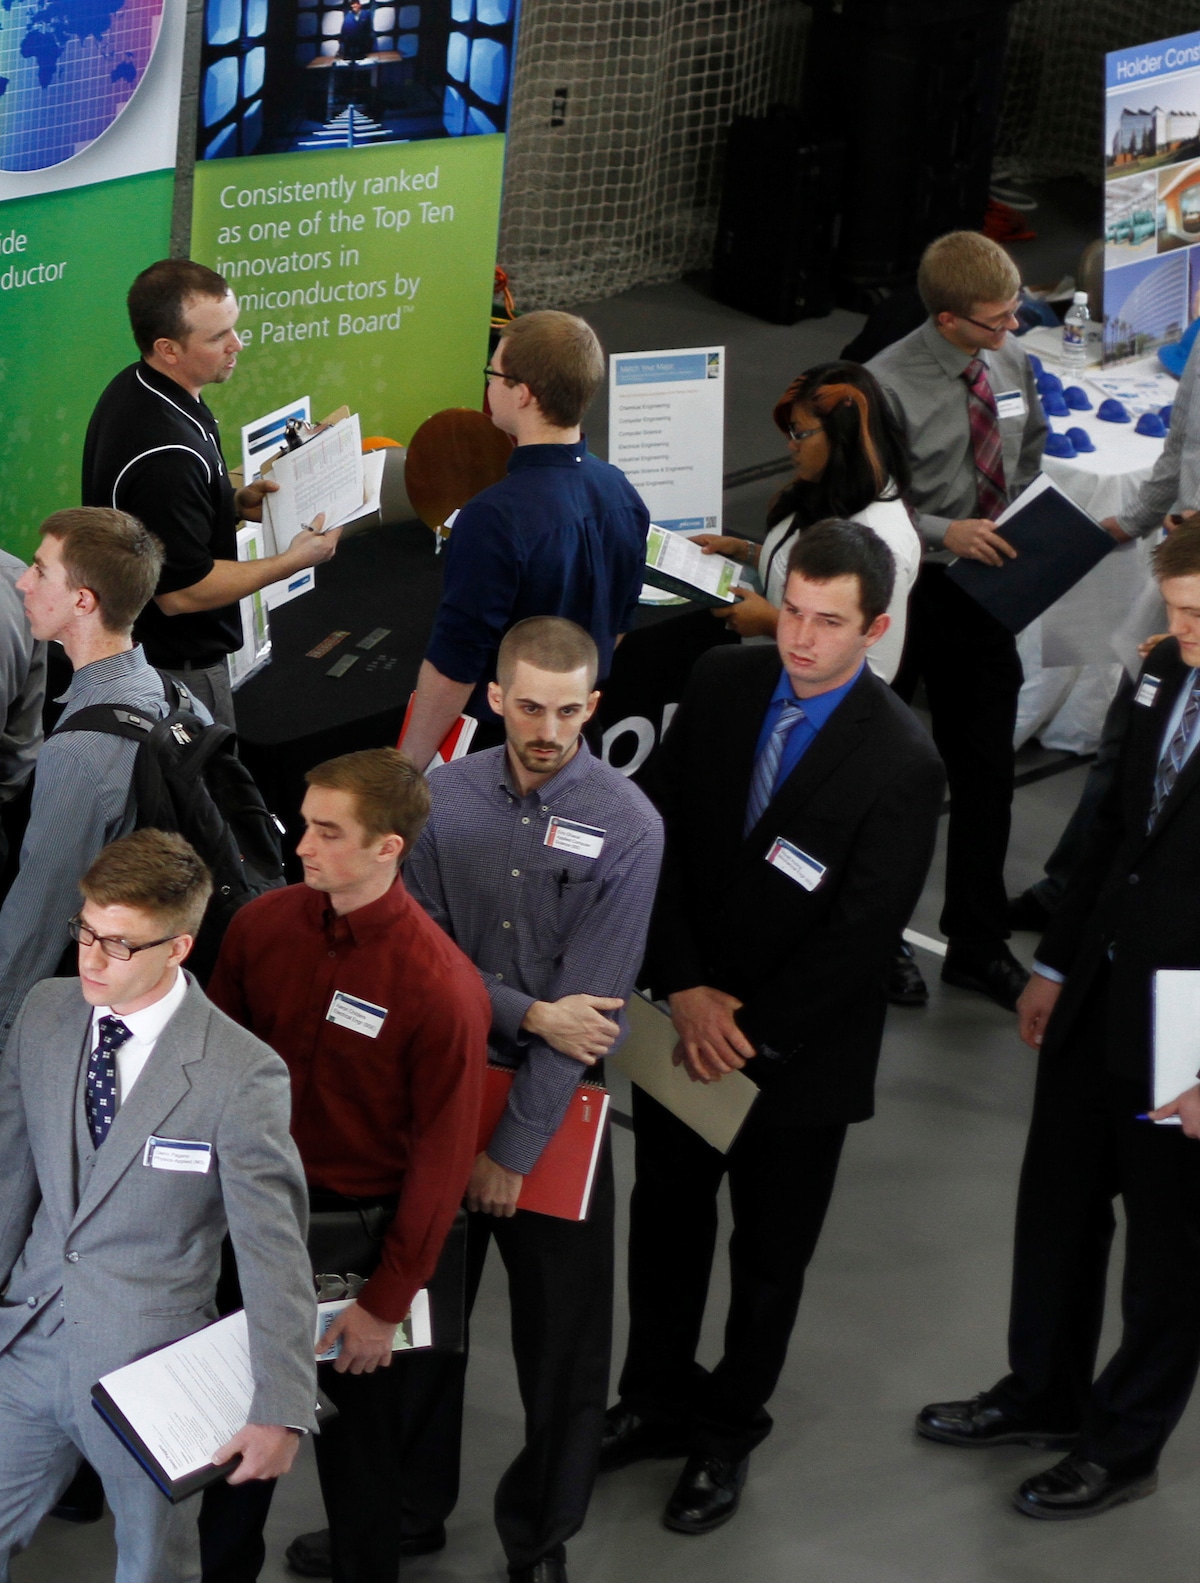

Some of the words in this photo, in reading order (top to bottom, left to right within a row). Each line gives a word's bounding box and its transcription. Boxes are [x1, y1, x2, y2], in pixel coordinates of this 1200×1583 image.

[1117, 55, 1163, 80] Holder
[220, 174, 357, 209] Consistently
[363, 165, 439, 196] ranked
[217, 225, 241, 244] as
[248, 220, 291, 242] one
[298, 210, 323, 236] of
[329, 209, 365, 233] the
[373, 206, 411, 232] Top
[419, 201, 454, 223] Ten
[216, 250, 331, 278] innovators
[340, 245, 360, 266] in
[238, 280, 387, 312] miconductors
[394, 273, 421, 300] by
[260, 317, 330, 344] Patent
